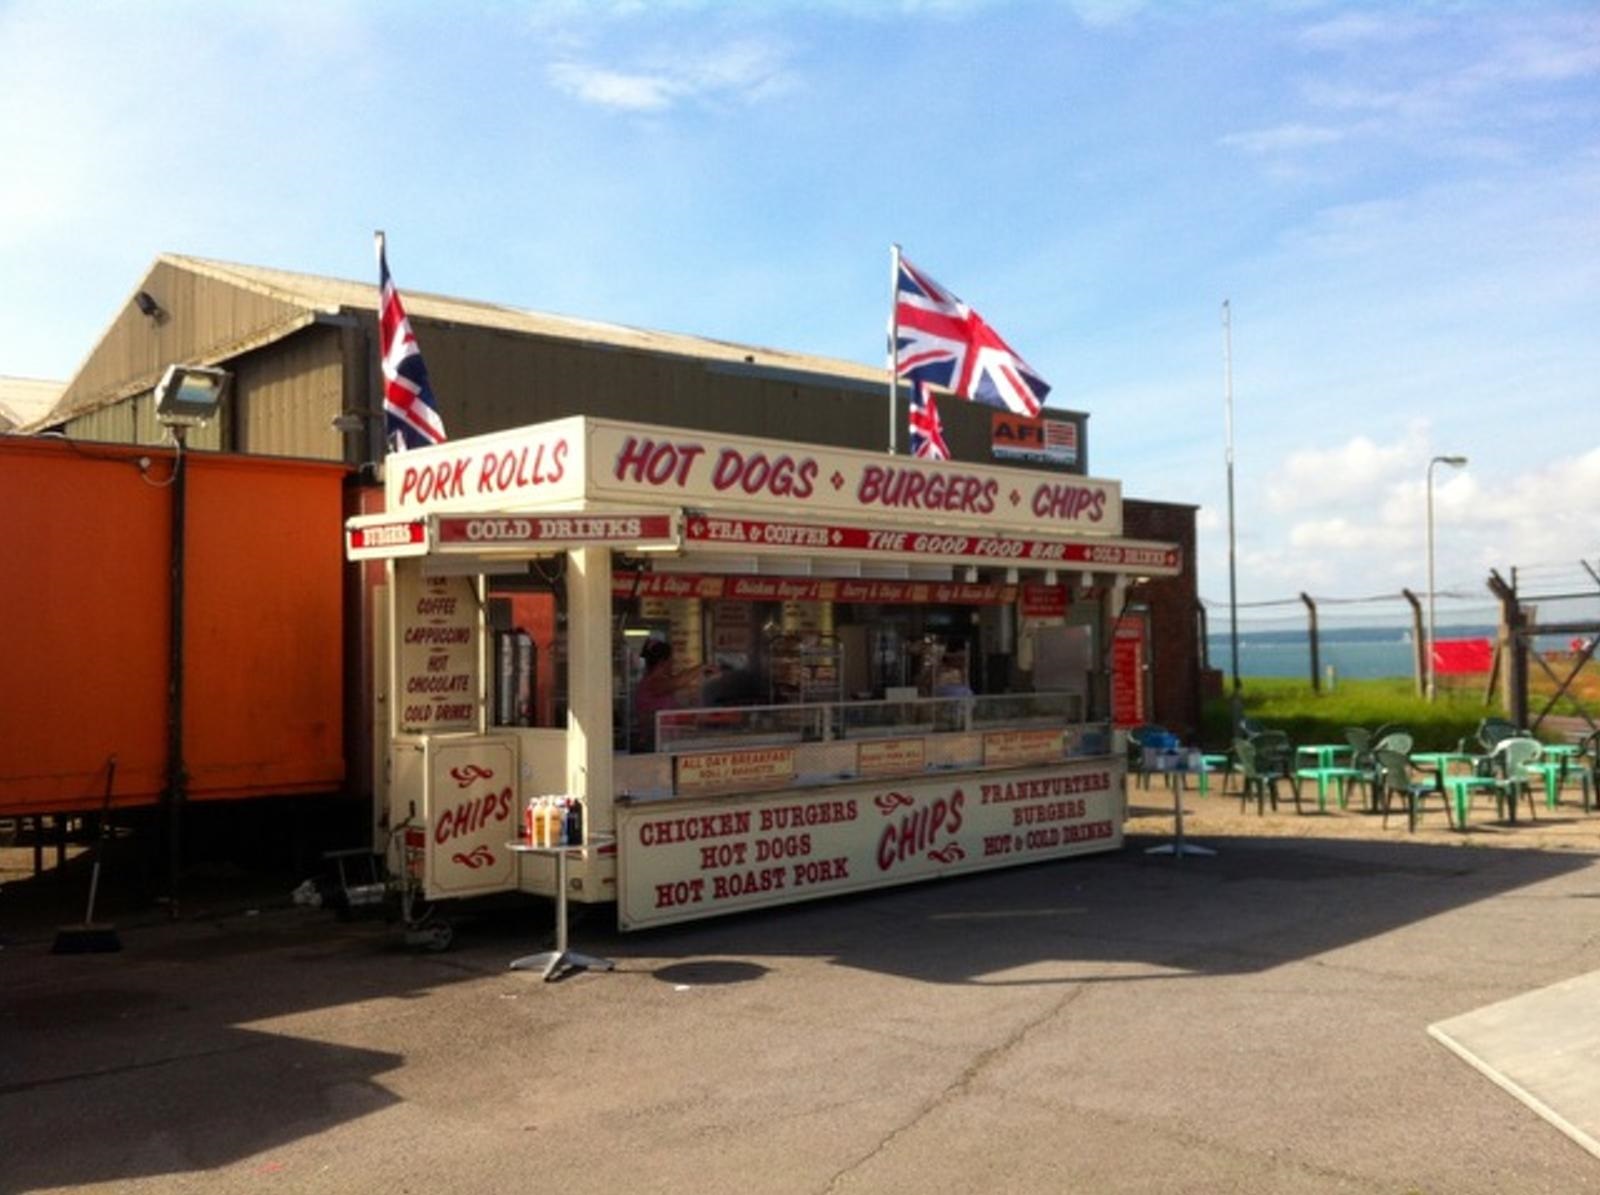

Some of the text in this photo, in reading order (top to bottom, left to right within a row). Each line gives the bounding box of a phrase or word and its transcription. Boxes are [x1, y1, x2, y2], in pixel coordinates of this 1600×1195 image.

[400, 439, 569, 505] PORK ROLLS
[614, 436, 1106, 522] HOT DOGS BURGERS CHIPS
[466, 517, 642, 541] COLD DRINKS
[708, 521, 829, 545] TEA & COFFEE
[866, 531, 1067, 561] THE GOOD FOOD BAR
[1093, 546, 1166, 566] COLD DRINKS
[417, 598, 457, 615] COFFEE
[404, 627, 471, 645] CAPPUCCINO
[427, 655, 449, 672] HOT
[407, 675, 470, 695] CHOCOLATE
[404, 703, 473, 722] COLD DRINKS
[980, 772, 1111, 804] FRANKFURTERS
[434, 786, 513, 845] CHIPS
[639, 800, 858, 846] CHICKEN BURGERS
[1012, 799, 1087, 827] BURGERS
[876, 788, 965, 872] CHIPS
[983, 835, 1013, 857] HOT
[1026, 829, 1060, 851] COLD
[1063, 820, 1114, 844] DRINKS
[700, 834, 811, 870] HOT DOGS
[655, 857, 849, 909] HOT ROAST PORK
